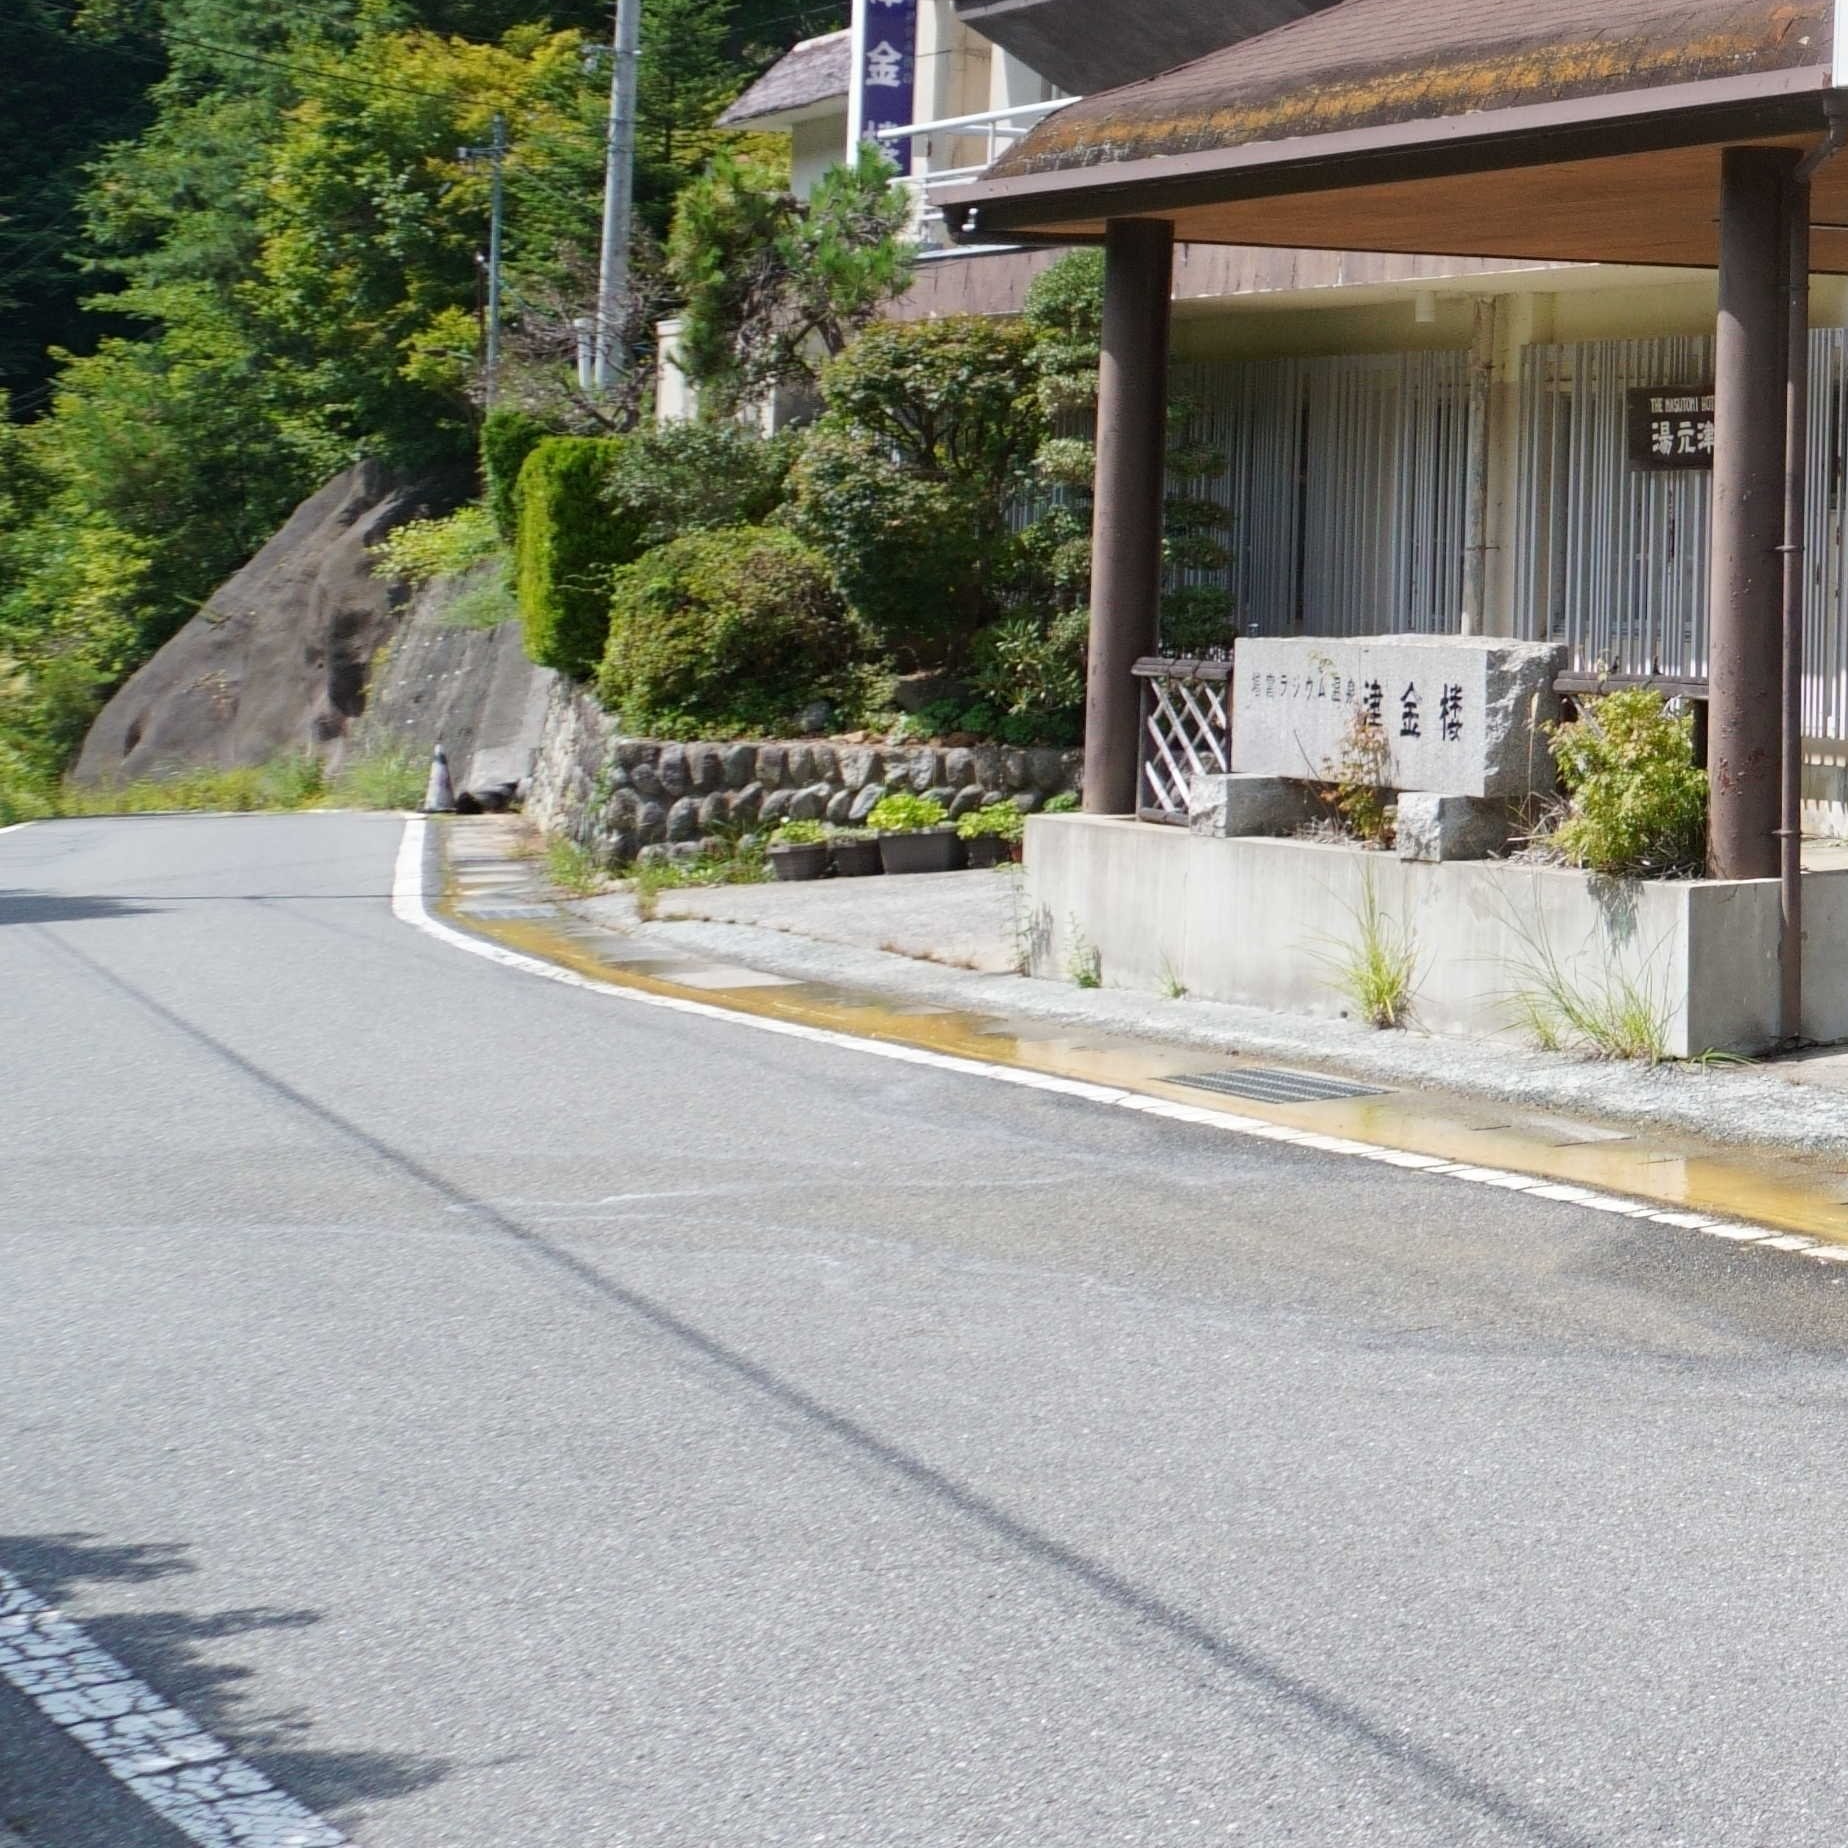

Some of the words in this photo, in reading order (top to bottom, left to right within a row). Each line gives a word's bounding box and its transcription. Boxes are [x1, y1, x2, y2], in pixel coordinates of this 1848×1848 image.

[1652, 421, 1714, 455] 湯元津
[1364, 679, 1463, 741] 津金楼
